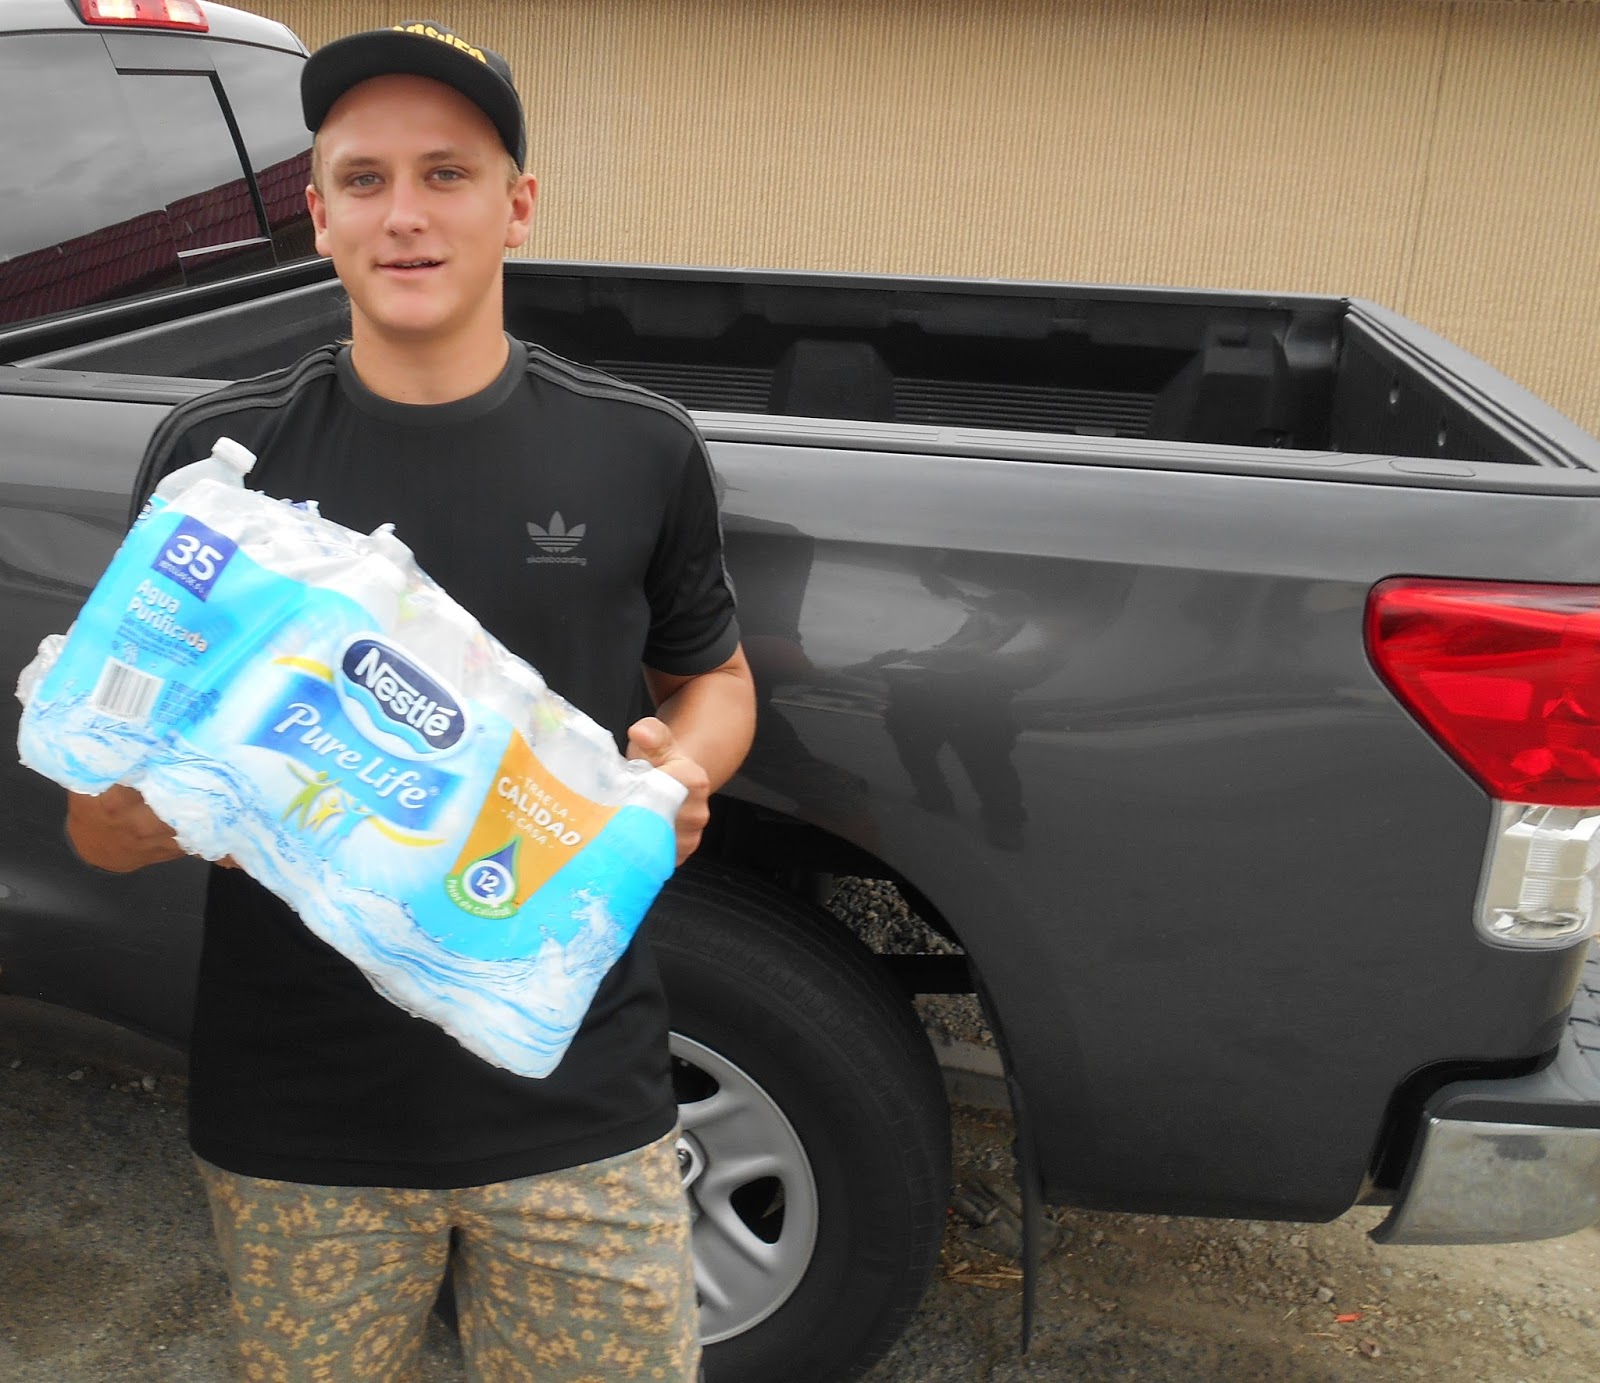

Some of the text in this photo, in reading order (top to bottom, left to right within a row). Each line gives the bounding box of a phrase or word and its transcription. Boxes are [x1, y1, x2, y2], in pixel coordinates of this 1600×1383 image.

[166, 534, 224, 581] 35
[135, 579, 181, 615] Agua
[127, 597, 209, 652] Purificada
[354, 647, 458, 737] Nestlé
[274, 702, 363, 770] Pure
[356, 754, 429, 810] Life
[497, 776, 582, 846] CALIDAD
[524, 777, 569, 818] TRAE LA
[516, 817, 548, 845] CASA
[476, 869, 500, 893] 12
